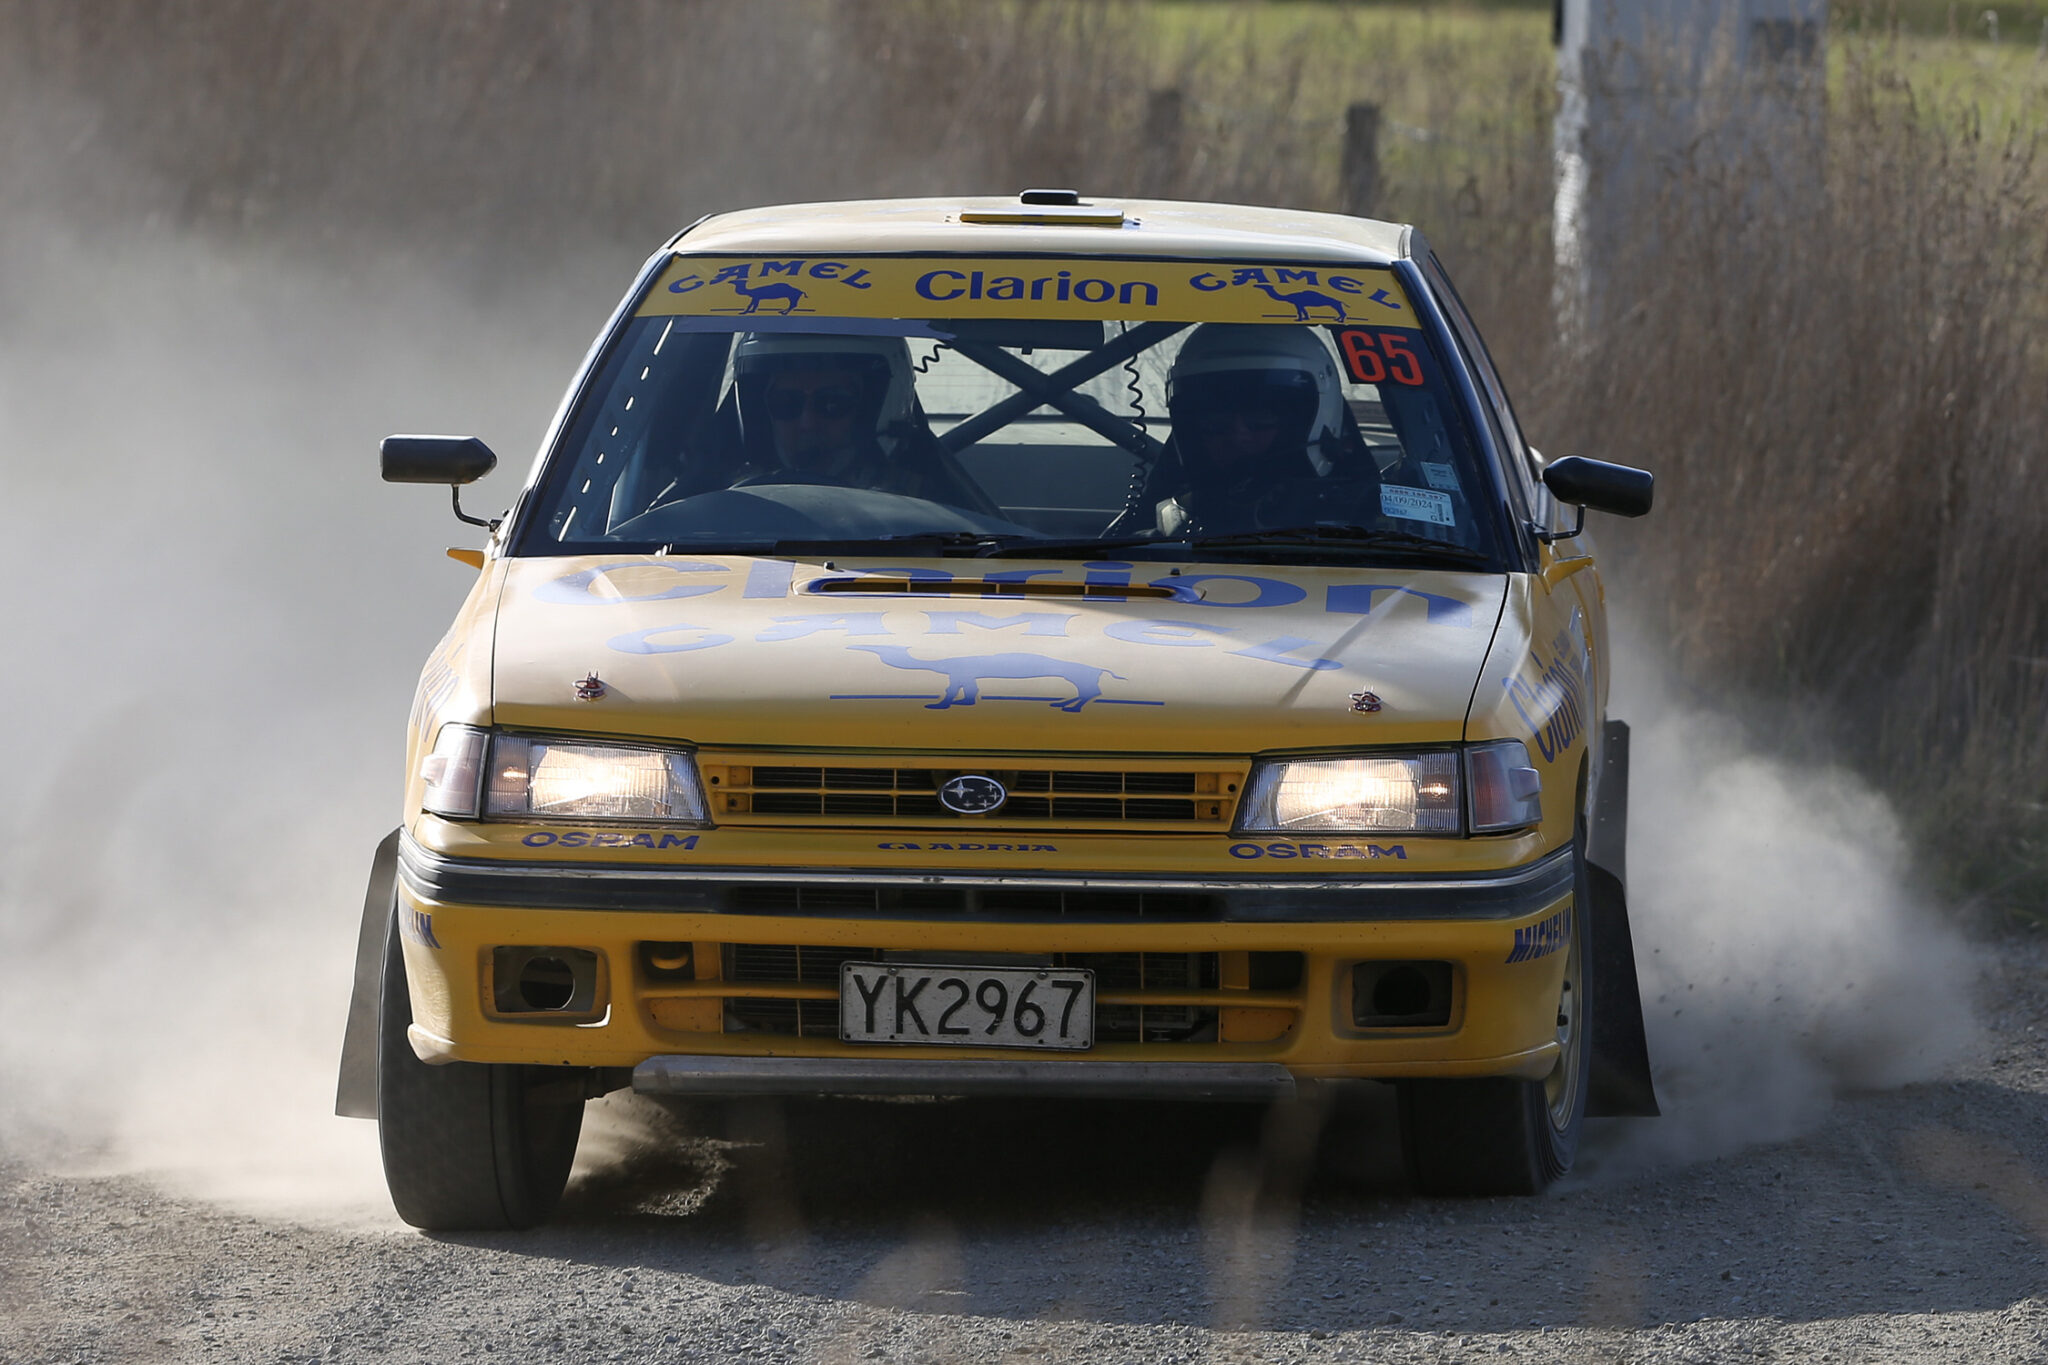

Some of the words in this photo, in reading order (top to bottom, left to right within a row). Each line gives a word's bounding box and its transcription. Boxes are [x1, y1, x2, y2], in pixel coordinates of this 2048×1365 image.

[668, 260, 872, 294] CAMEL
[915, 270, 1159, 306] Clarion
[1190, 268, 1402, 309] CAMEL
[1340, 330, 1425, 386] 65
[606, 610, 1344, 672] CAMEL
[522, 831, 700, 851] OSRAM
[1228, 843, 1408, 860] OSRAM
[853, 974, 1086, 1039] YK2967
